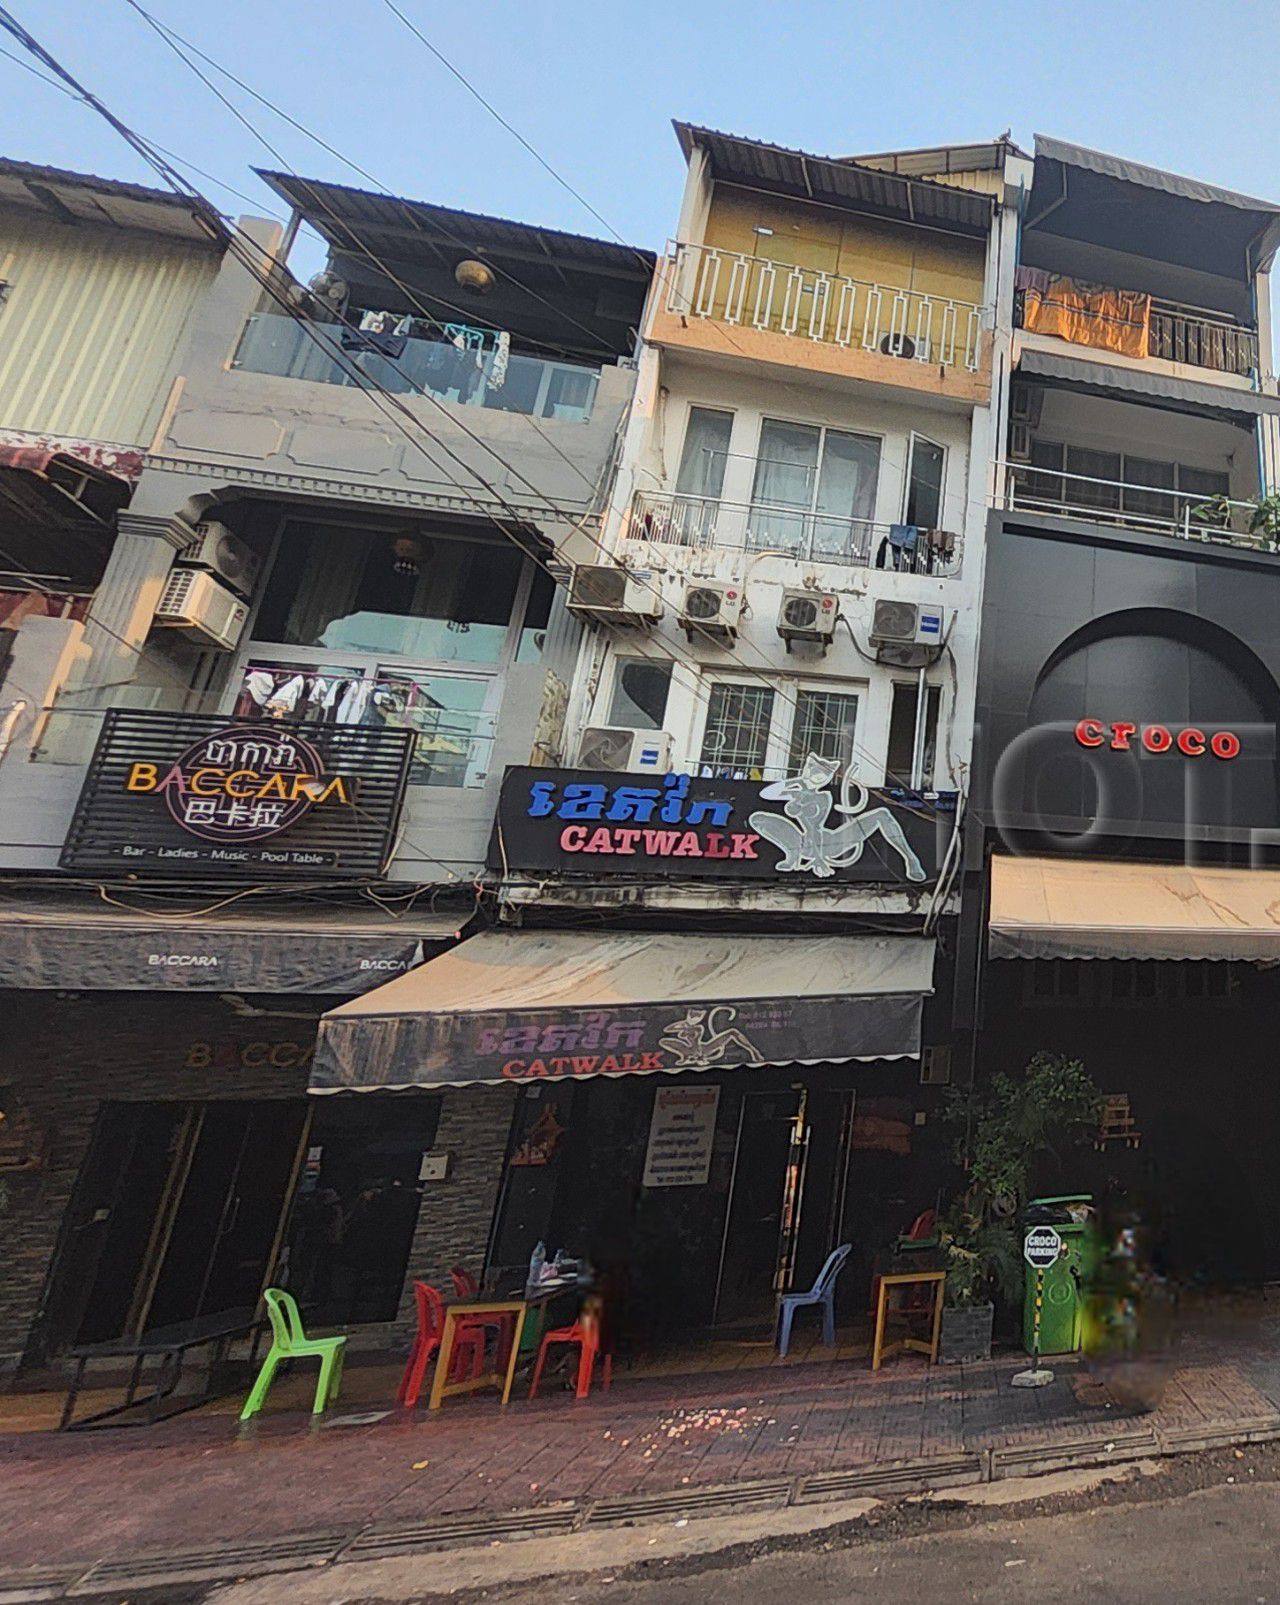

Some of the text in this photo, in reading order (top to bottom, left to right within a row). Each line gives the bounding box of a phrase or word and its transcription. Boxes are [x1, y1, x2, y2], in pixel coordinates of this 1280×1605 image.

[1075, 718, 1240, 759] croco
[126, 763, 347, 804] BACCARA
[184, 798, 285, 829] 巴卡拉
[123, 846, 324, 864] Bar Ladies Music Pool Table
[560, 825, 761, 859] CATWALK
[148, 953, 218, 967] BACCARA
[360, 959, 408, 970] BACCA
[502, 1052, 665, 1077] CATWALK
